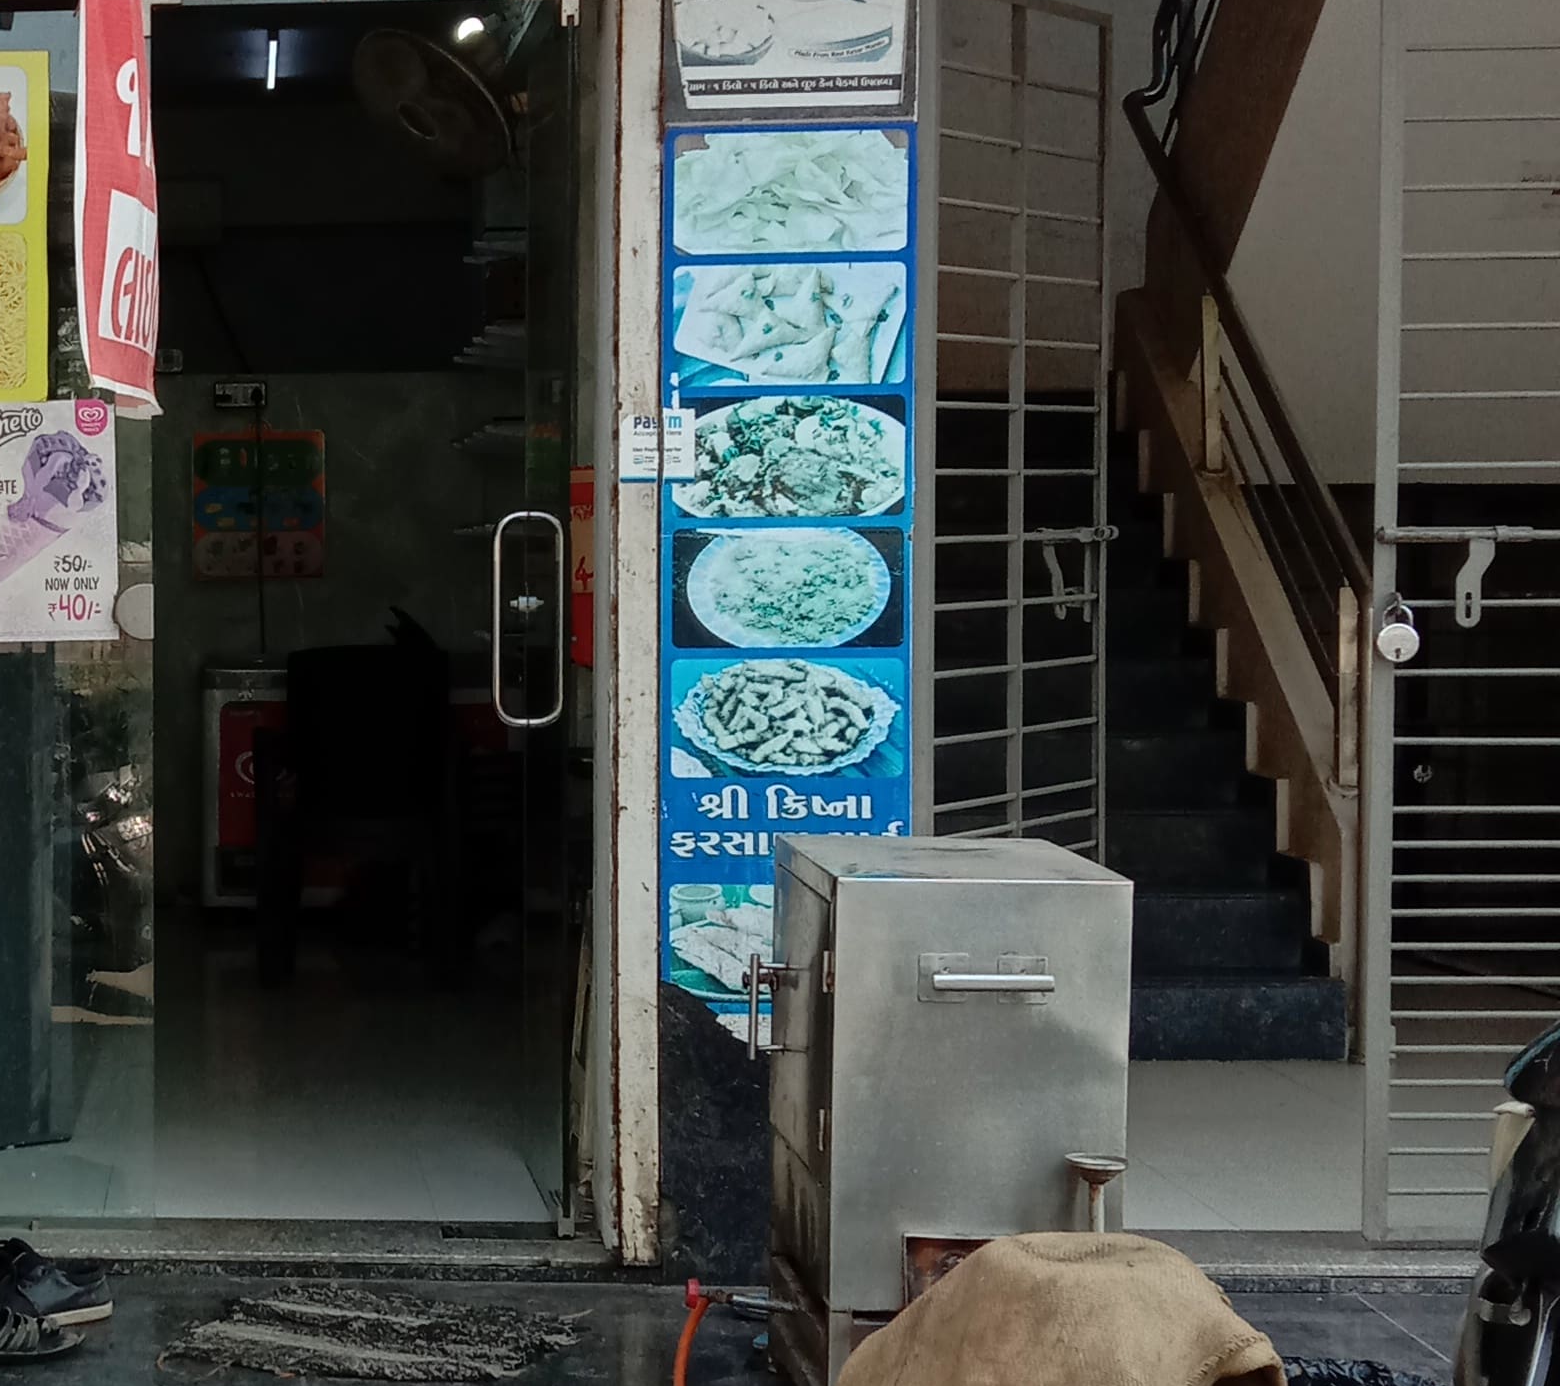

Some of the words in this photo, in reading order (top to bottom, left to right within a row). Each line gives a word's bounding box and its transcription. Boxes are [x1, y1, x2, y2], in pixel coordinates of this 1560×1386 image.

[45, 578, 70, 591] NOW
[74, 577, 99, 590] ONLY
[697, 785, 749, 820] શ્રી
[670, 831, 776, 858] ફરસા
